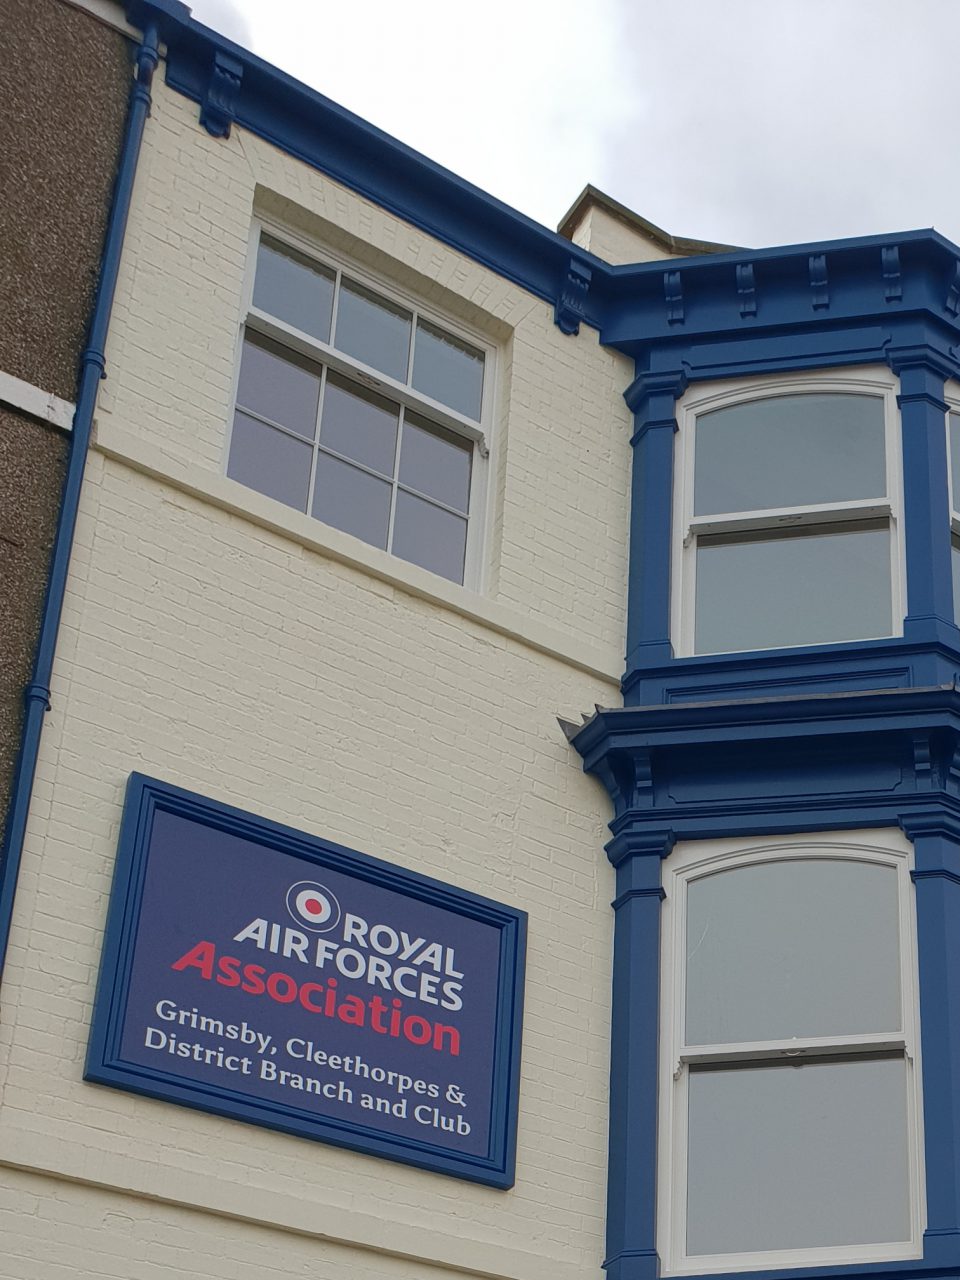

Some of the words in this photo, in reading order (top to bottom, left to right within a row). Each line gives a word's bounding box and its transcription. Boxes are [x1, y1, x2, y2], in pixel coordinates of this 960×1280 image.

[171, 941, 460, 1056] Association
[233, 917, 308, 963] AIR
[316, 939, 463, 1012] FORCES
[343, 913, 465, 980] ROYAL
[144, 1027, 251, 1075] District
[260, 1060, 353, 1103] Branch
[360, 1093, 407, 1118] and
[414, 1106, 471, 1135] Club
[155, 1000, 277, 1055] Grimsby,
[286, 1038, 439, 1099] Cleethorpes
[445, 1085, 467, 1107] &
